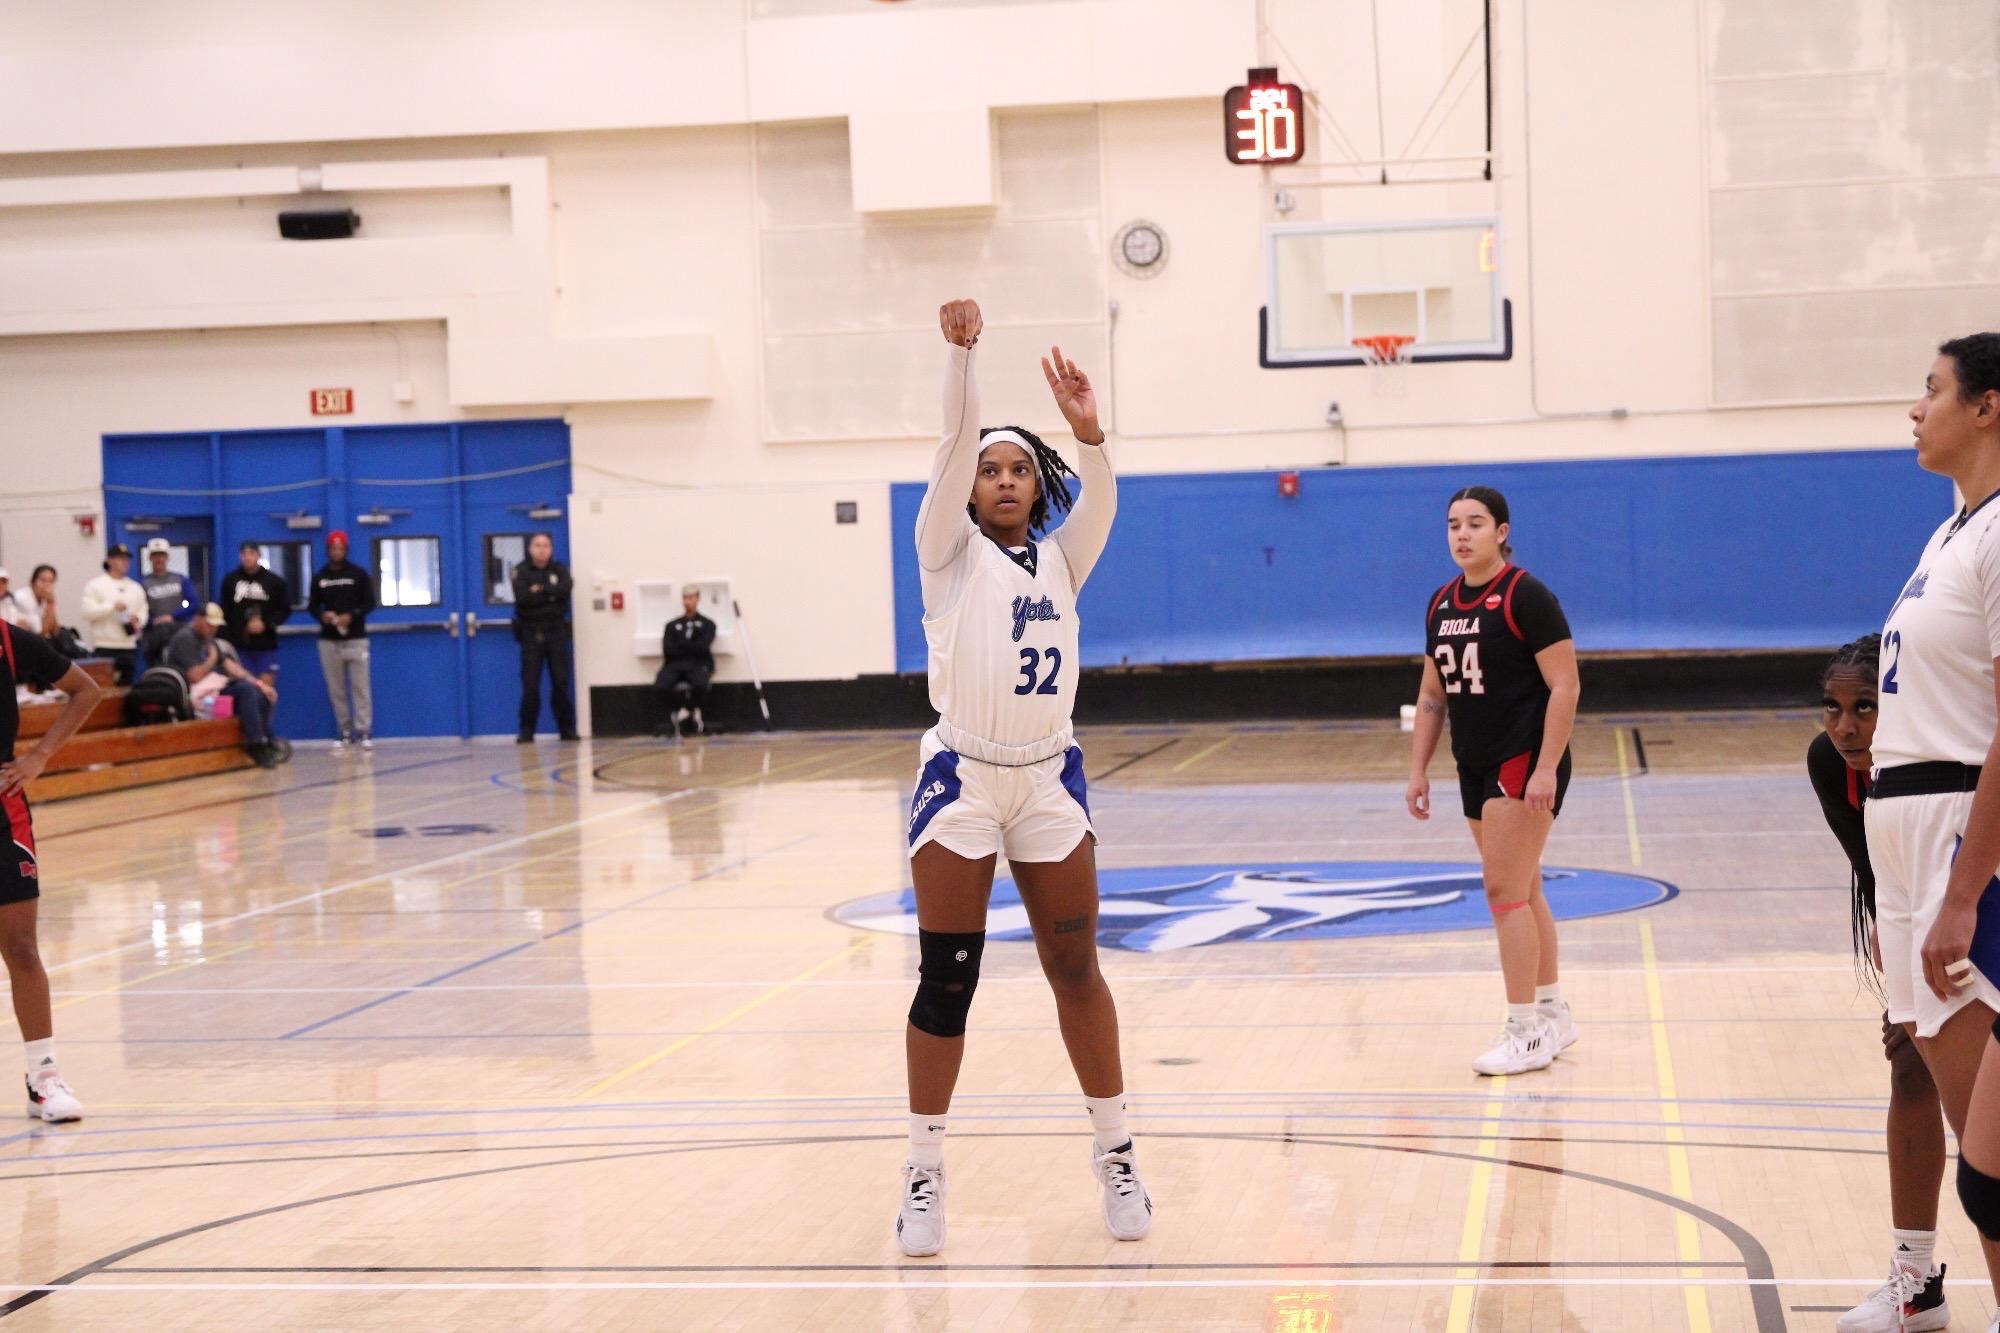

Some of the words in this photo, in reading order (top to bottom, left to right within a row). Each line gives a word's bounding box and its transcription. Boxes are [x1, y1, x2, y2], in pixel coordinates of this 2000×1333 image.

[1236, 107, 1296, 159] 30
[316, 390, 347, 412] EXIT
[1438, 617, 1480, 636] BIOLA
[1014, 647, 1062, 695] 32
[1434, 642, 1485, 694] 24
